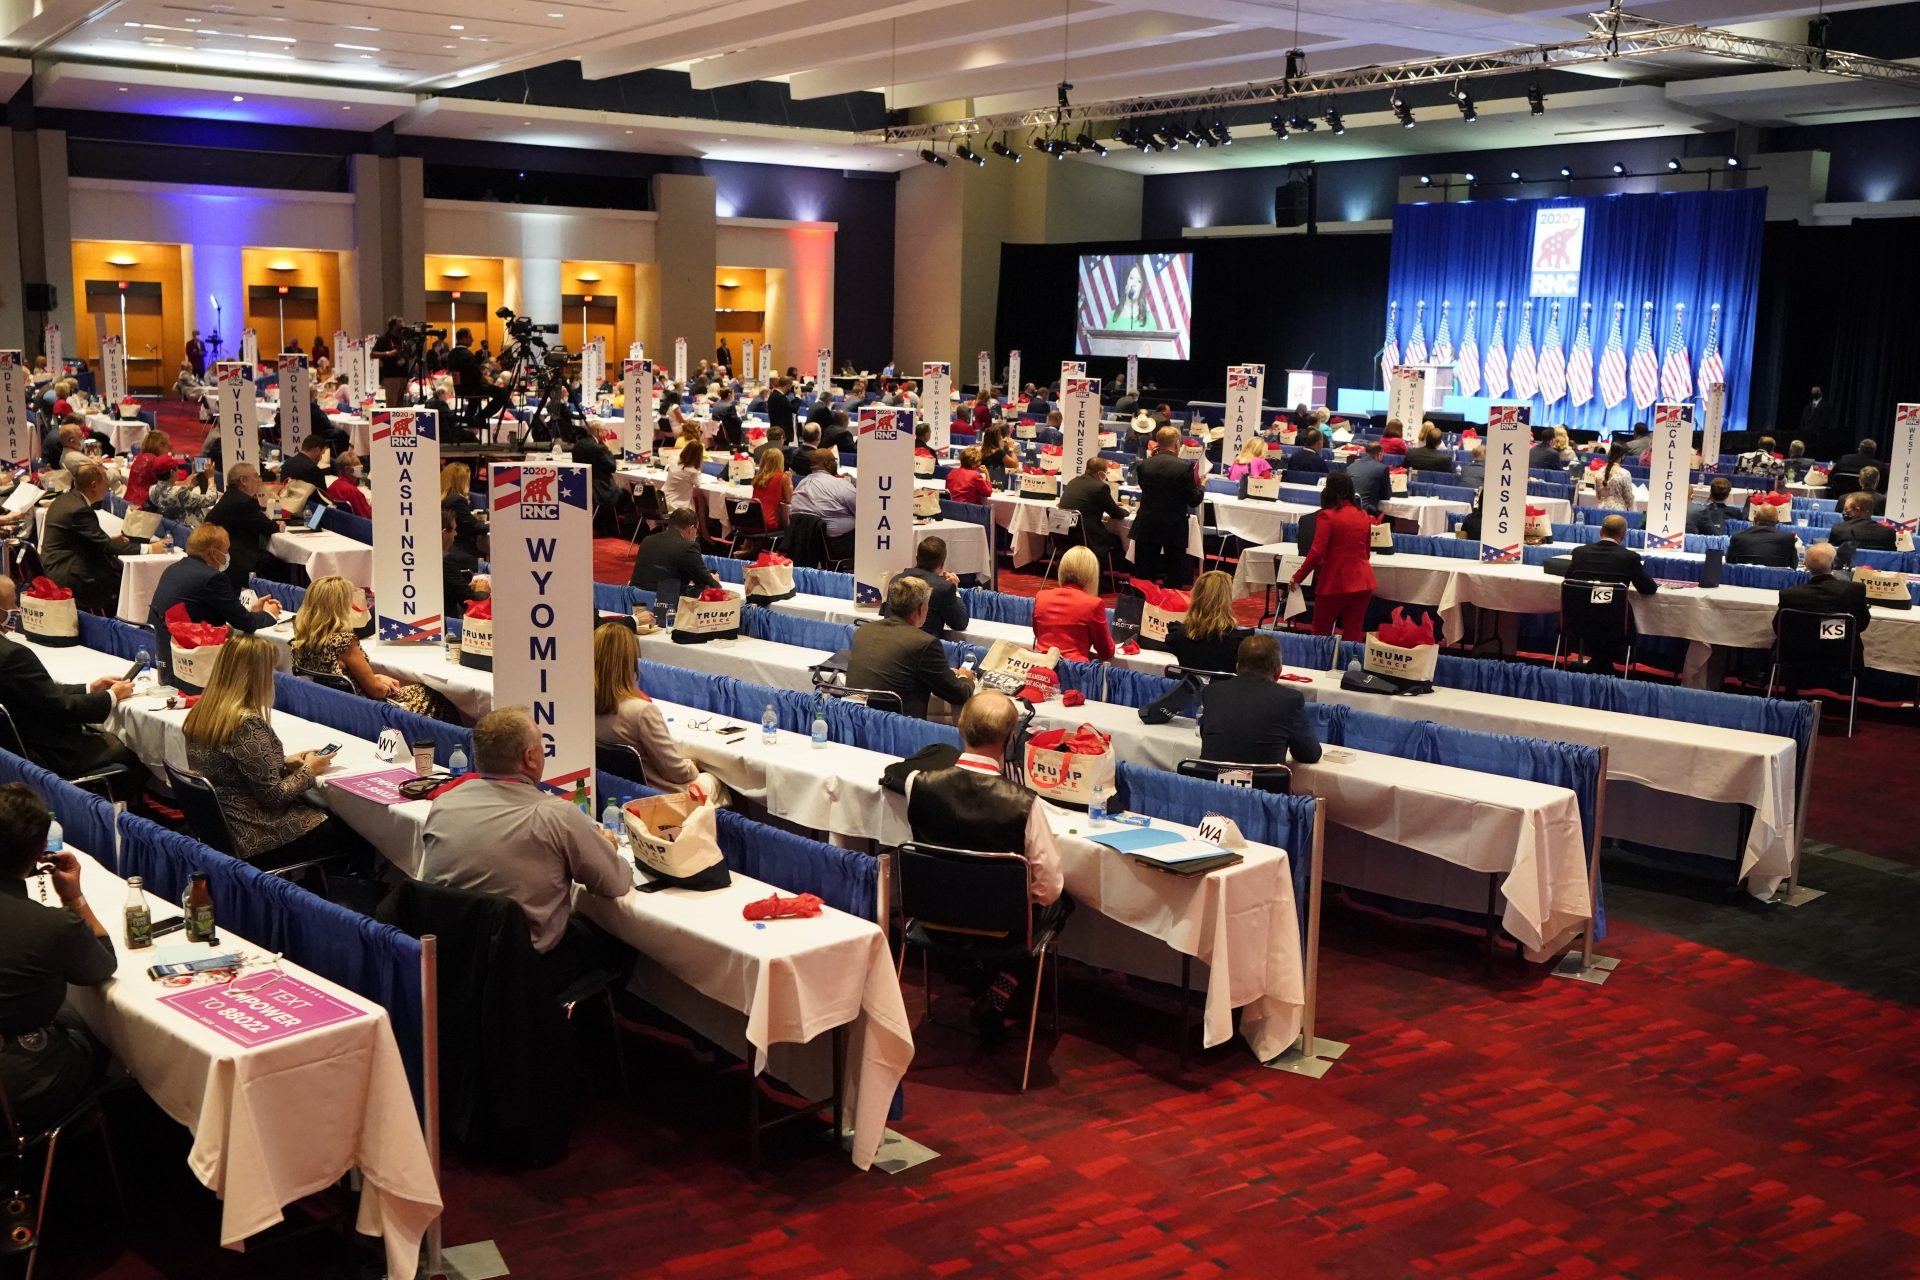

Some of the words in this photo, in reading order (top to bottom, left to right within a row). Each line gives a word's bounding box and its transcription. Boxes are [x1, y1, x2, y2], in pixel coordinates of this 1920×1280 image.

[1540, 213, 1570, 224] 2020
[1532, 273, 1578, 294] RNC
[352, 357, 360, 400] ALASKA
[4, 372, 17, 459] DELAWARE
[290, 374, 300, 454] OKLAHOMA
[1406, 383, 1417, 439] MICHIGAN
[232, 387, 245, 461] VIRGIN
[1233, 395, 1245, 456] ALABAM
[391, 437, 417, 447] RNC
[875, 431, 897, 440] RNC
[1076, 400, 1086, 474] TENNESSE
[1908, 426, 1916, 455] WEST
[522, 467, 548, 475] 2020
[1662, 429, 1677, 533] CALIFORNIA
[1498, 442, 1513, 534] KANSAS
[1899, 461, 1911, 519] VIRGINIA
[521, 505, 559, 519] RNC
[737, 503, 748, 511] AR
[877, 475, 892, 550] UTAH
[396, 451, 416, 616] WASHINGTON
[1860, 578, 1900, 588] TRUMP
[1592, 590, 1611, 601] KS
[21, 606, 44, 618] TRUMP
[697, 610, 735, 620] TRUMP
[699, 617, 730, 625] PENCE
[1148, 615, 1168, 626] TRU
[1150, 624, 1166, 632] PEN
[1822, 624, 1844, 635] KS
[526, 537, 557, 758] WYOMING
[1370, 649, 1413, 662] TRUMP
[1007, 665, 1026, 675] PEN
[1372, 657, 1408, 669] PENCE
[378, 736, 397, 754] WY
[1199, 821, 1223, 844] WA
[220, 987, 303, 1029] EMPOWER
[266, 988, 314, 1010] TEXT
[199, 996, 226, 1011] TO
[217, 1007, 270, 1034] 88022
